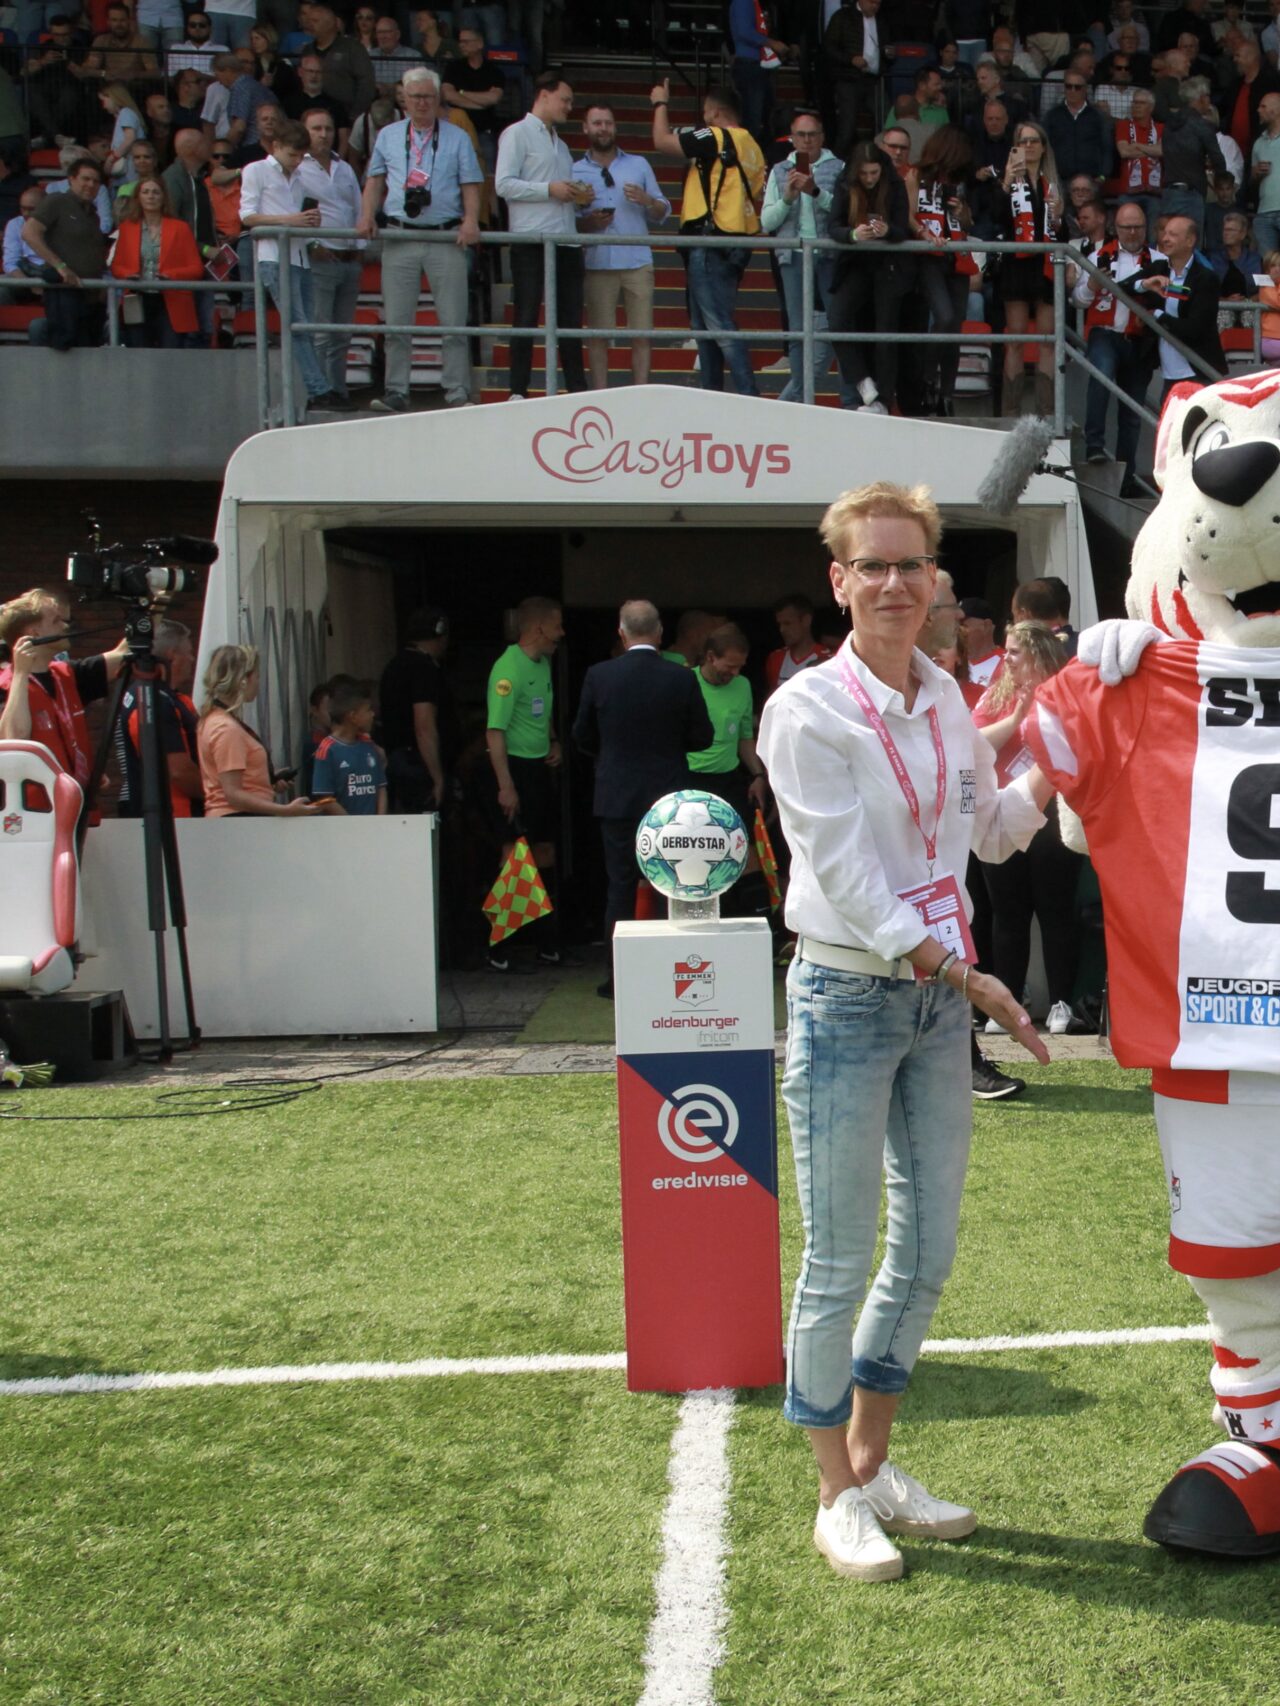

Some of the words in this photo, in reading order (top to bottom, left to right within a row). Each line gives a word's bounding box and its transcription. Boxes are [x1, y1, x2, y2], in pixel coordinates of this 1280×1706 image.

[560, 420, 791, 489] EasyToys
[348, 773, 372, 785] Euro
[662, 836, 725, 850] DERBYSTAR
[945, 926, 953, 934] 2
[1188, 995, 1249, 1024] SPORT
[1250, 997, 1265, 1025] &
[652, 1016, 740, 1030] oldenburger
[652, 1171, 748, 1190] eredivisie
